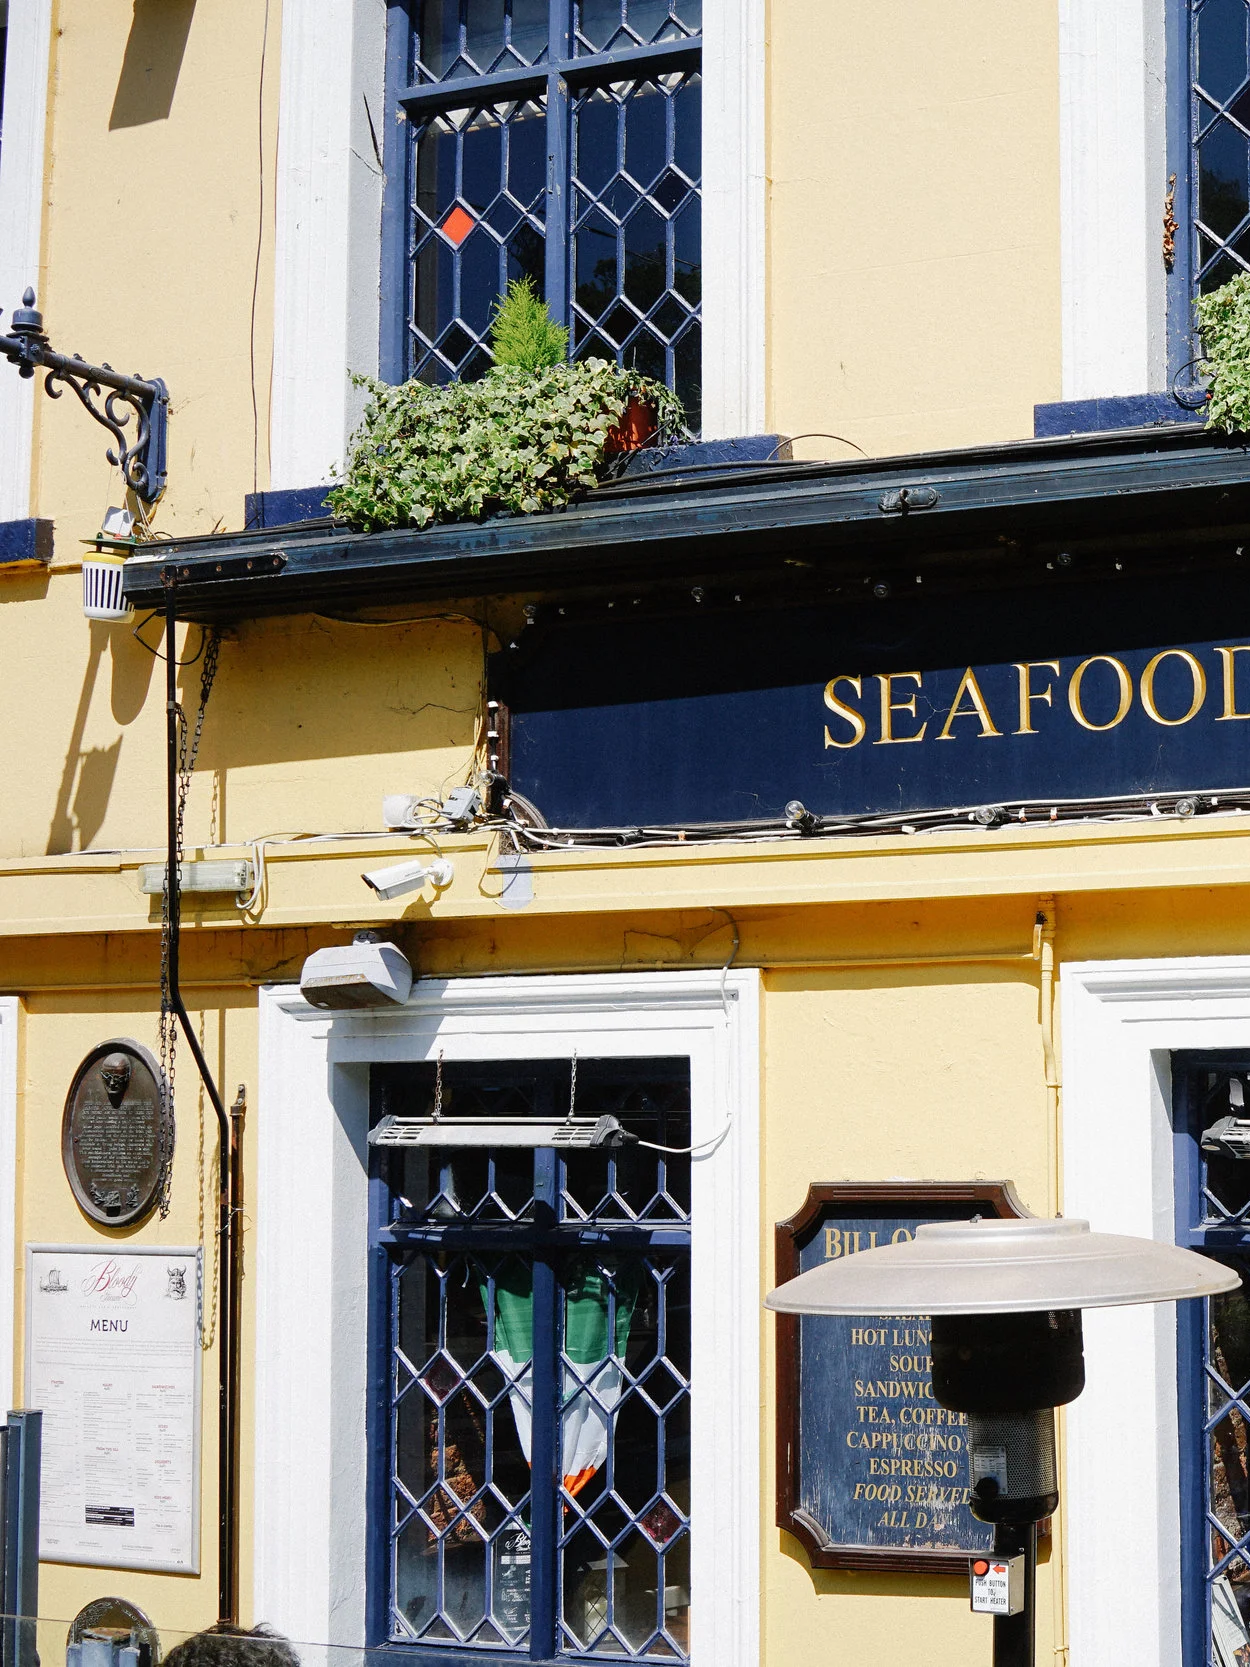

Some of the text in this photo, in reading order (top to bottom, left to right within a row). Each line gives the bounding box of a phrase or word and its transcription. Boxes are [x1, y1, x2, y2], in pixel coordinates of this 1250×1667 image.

[90, 1319, 128, 1332] MENU
[851, 1328, 933, 1347] HOT LUN
[857, 1406, 896, 1426] TEA,
[846, 1431, 961, 1452] CAPPUCCINO
[869, 1458, 957, 1478] ESPRESSO
[853, 1483, 902, 1501] FOOD
[878, 1511, 910, 1528] ALL
[975, 1579, 1006, 1588] PUSH BUTTON
[975, 1596, 1006, 1605] START HEATER
